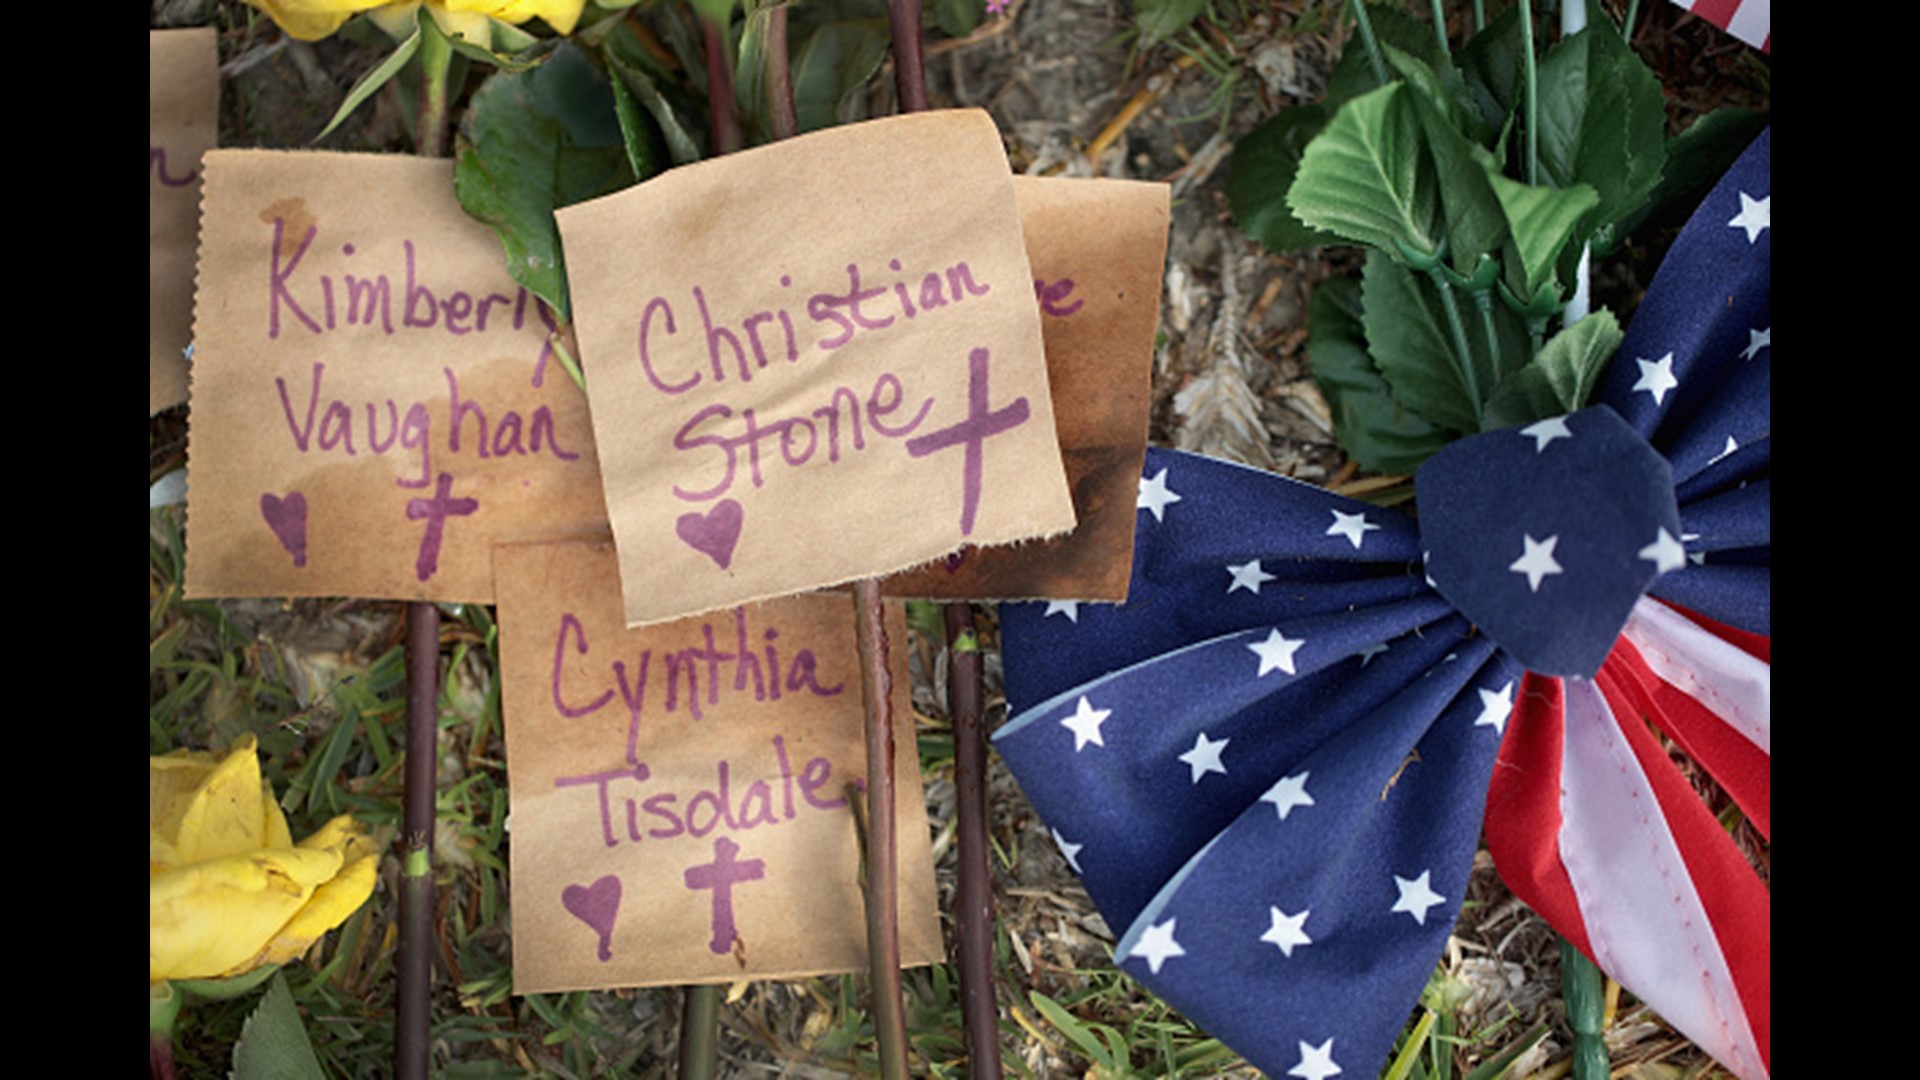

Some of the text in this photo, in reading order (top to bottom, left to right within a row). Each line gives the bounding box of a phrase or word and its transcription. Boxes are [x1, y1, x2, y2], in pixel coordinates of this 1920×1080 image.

[638, 258, 991, 394] Christian
[275, 362, 580, 488] Vaughan
[672, 372, 935, 502] Stone
[552, 605, 845, 764] Cynthia
[554, 734, 868, 847] Tisdale
